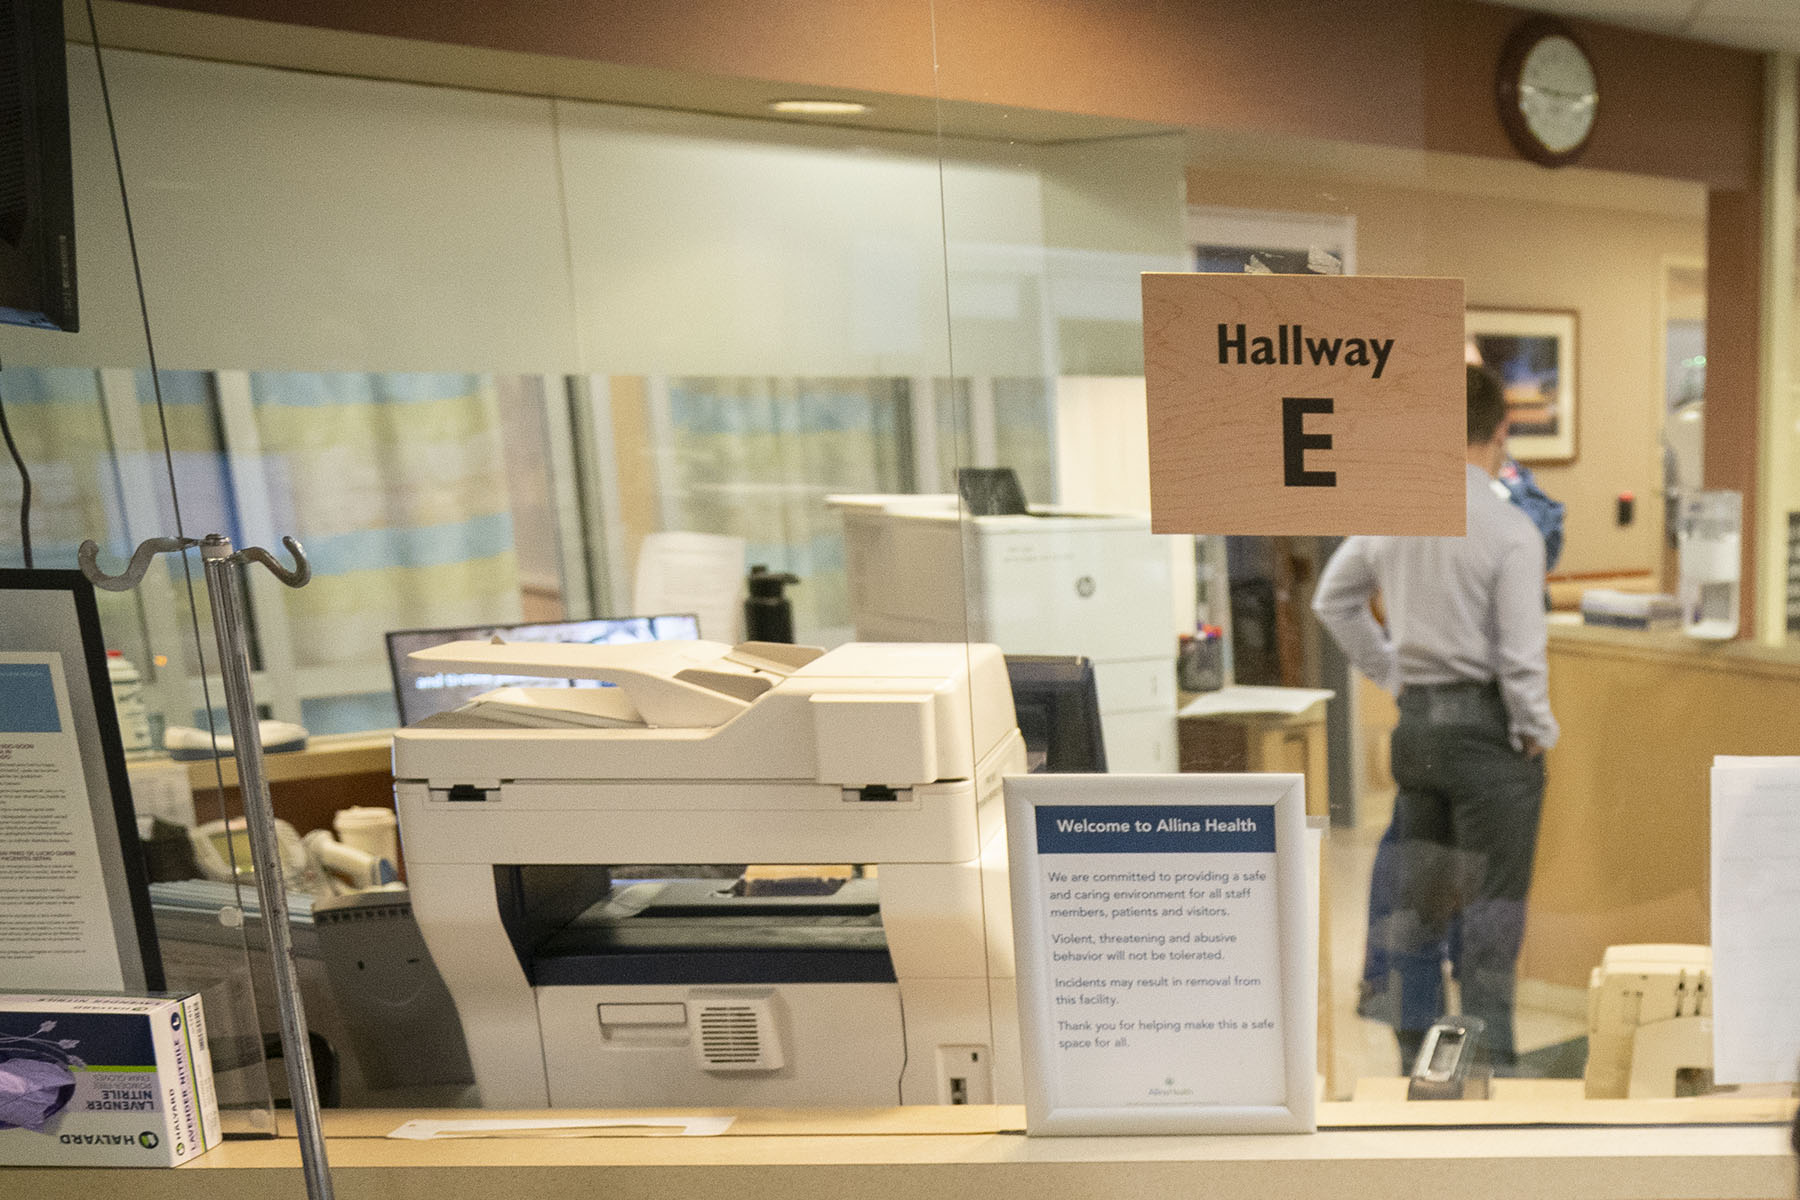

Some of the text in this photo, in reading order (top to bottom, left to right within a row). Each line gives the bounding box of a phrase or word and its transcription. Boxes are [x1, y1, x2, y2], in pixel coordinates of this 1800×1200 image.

[1217, 323, 1395, 379] Hallway
[1282, 397, 1337, 487] E
[1056, 818, 1257, 833] Welcome to Allina Health
[1048, 870, 1266, 884] We are committed to providing a safe
[1050, 888, 1251, 902] and caring environment for all staff
[1050, 906, 1230, 919] members, patients and visitors.
[1052, 933, 1237, 946] Violent, threatening and abusive
[1053, 950, 1225, 961] behavior will not be tolerated.
[1055, 975, 1261, 990] Incidents may result in removal from
[1056, 994, 1119, 1007] this facility.
[1058, 1020, 1091, 1031] Thank
[1095, 1022, 1116, 1032] you
[1119, 1020, 1135, 1030] for
[1139, 1020, 1181, 1032] helping
[1184, 1020, 1214, 1030] make
[1218, 1019, 1238, 1029] this
[1251, 1019, 1274, 1029] safe
[1059, 1038, 1130, 1050] space for all.
[174, 1039, 186, 1085] NITRILE
[102, 1090, 153, 1100] NITRILE
[87, 1100, 155, 1111] LAVENDER
[169, 1088, 181, 1140] HALYARD
[183, 1090, 196, 1151] LAVENDER
[60, 1133, 135, 1145] HALYARD
